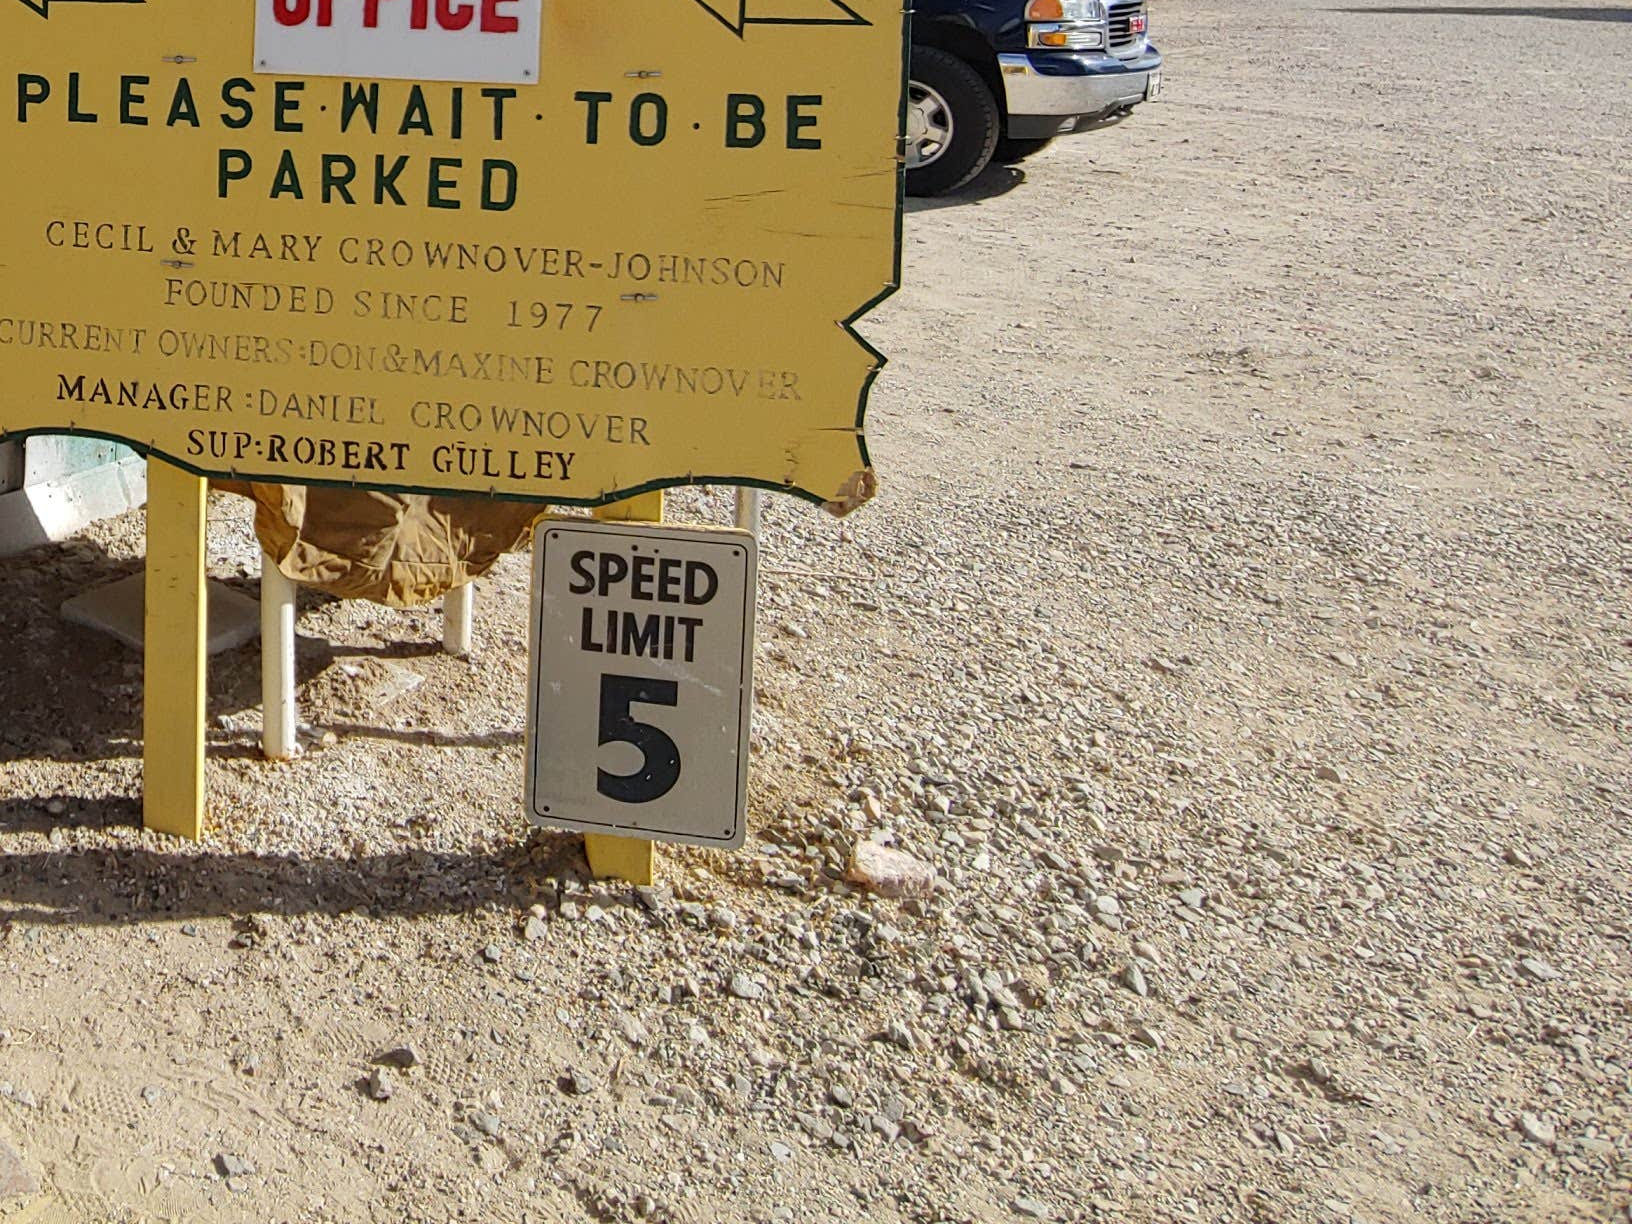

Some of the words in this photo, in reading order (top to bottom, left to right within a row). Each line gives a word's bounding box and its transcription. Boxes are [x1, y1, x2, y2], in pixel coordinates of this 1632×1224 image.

[574, 91, 668, 146] TO
[724, 93, 824, 151] BE
[217, 148, 519, 211] PARKED
[45, 220, 154, 253] CECIL
[171, 226, 197, 256] &
[211, 229, 323, 263] MARY
[338, 236, 786, 289] CROWNOVER-JOHNSON
[164, 278, 335, 315] FOUNDED
[354, 290, 469, 325] SINCE
[506, 300, 604, 334] 1977
[569, 358, 803, 402] CROWNOVER
[410, 401, 651, 446] CROWNOVER
[569, 550, 718, 605] SPEED
[580, 607, 703, 662] LIMIT
[596, 672, 682, 804] 5
